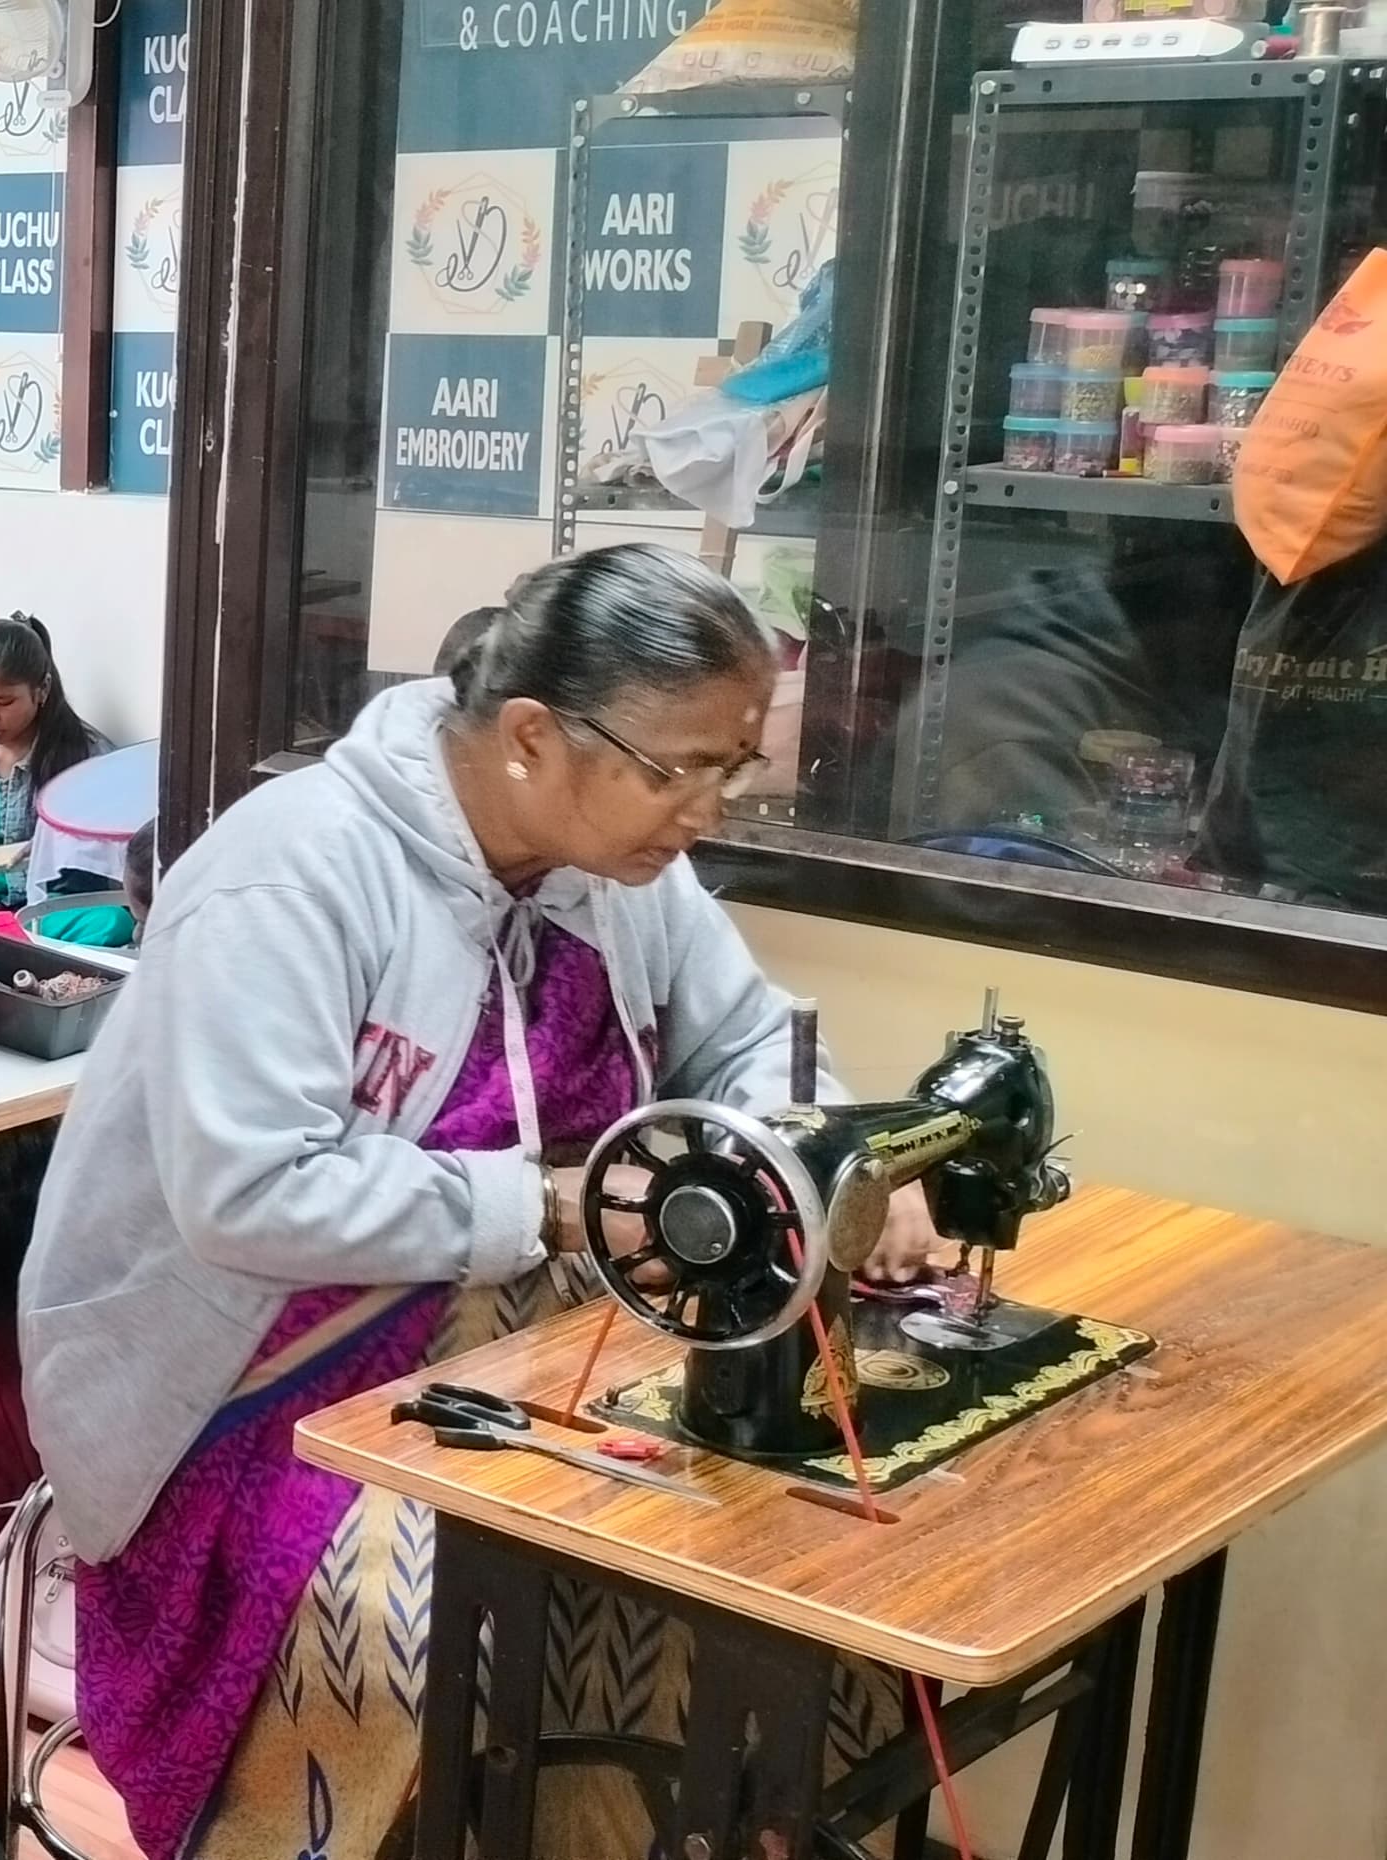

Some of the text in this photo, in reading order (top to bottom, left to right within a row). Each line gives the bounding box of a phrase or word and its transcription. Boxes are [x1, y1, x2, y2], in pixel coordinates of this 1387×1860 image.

[460, 7, 478, 50] &
[493, 0, 687, 48] COACHING
[602, 193, 674, 235] AARI
[584, 249, 691, 291] WORKS
[432, 378, 497, 417] AARI
[397, 428, 529, 470] EMBROIDERY
